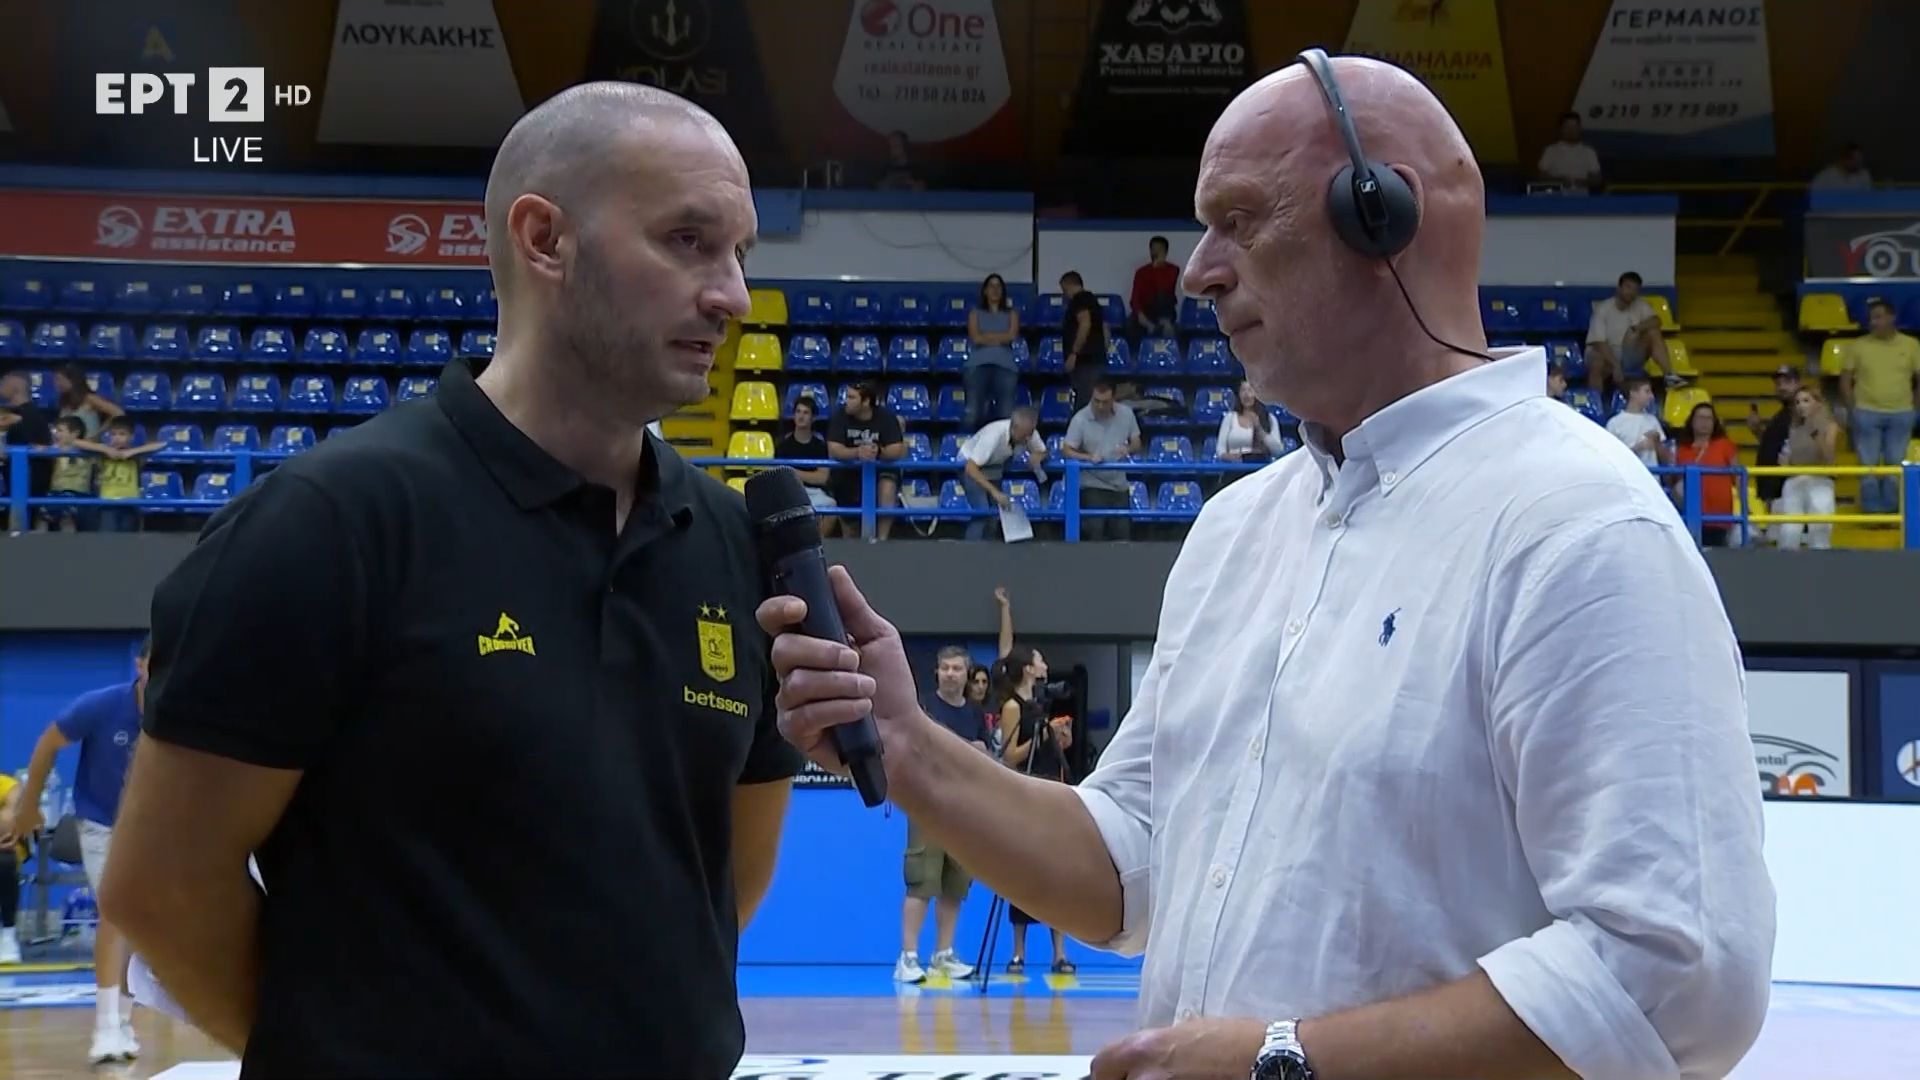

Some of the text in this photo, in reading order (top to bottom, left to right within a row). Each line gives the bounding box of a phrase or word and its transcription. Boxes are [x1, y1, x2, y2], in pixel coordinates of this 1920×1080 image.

[908, 3, 985, 39] One
[1611, 7, 1761, 28] ΓΕΡΜΑΝΟΣ
[342, 23, 495, 49] ΛΟΥΚΑΚΗΣ
[863, 40, 983, 53] REAL ESTATE
[1099, 64, 1163, 77] Premium
[152, 206, 296, 237] EXTRA
[150, 234, 297, 254] assistance
[683, 684, 749, 718] betsson
